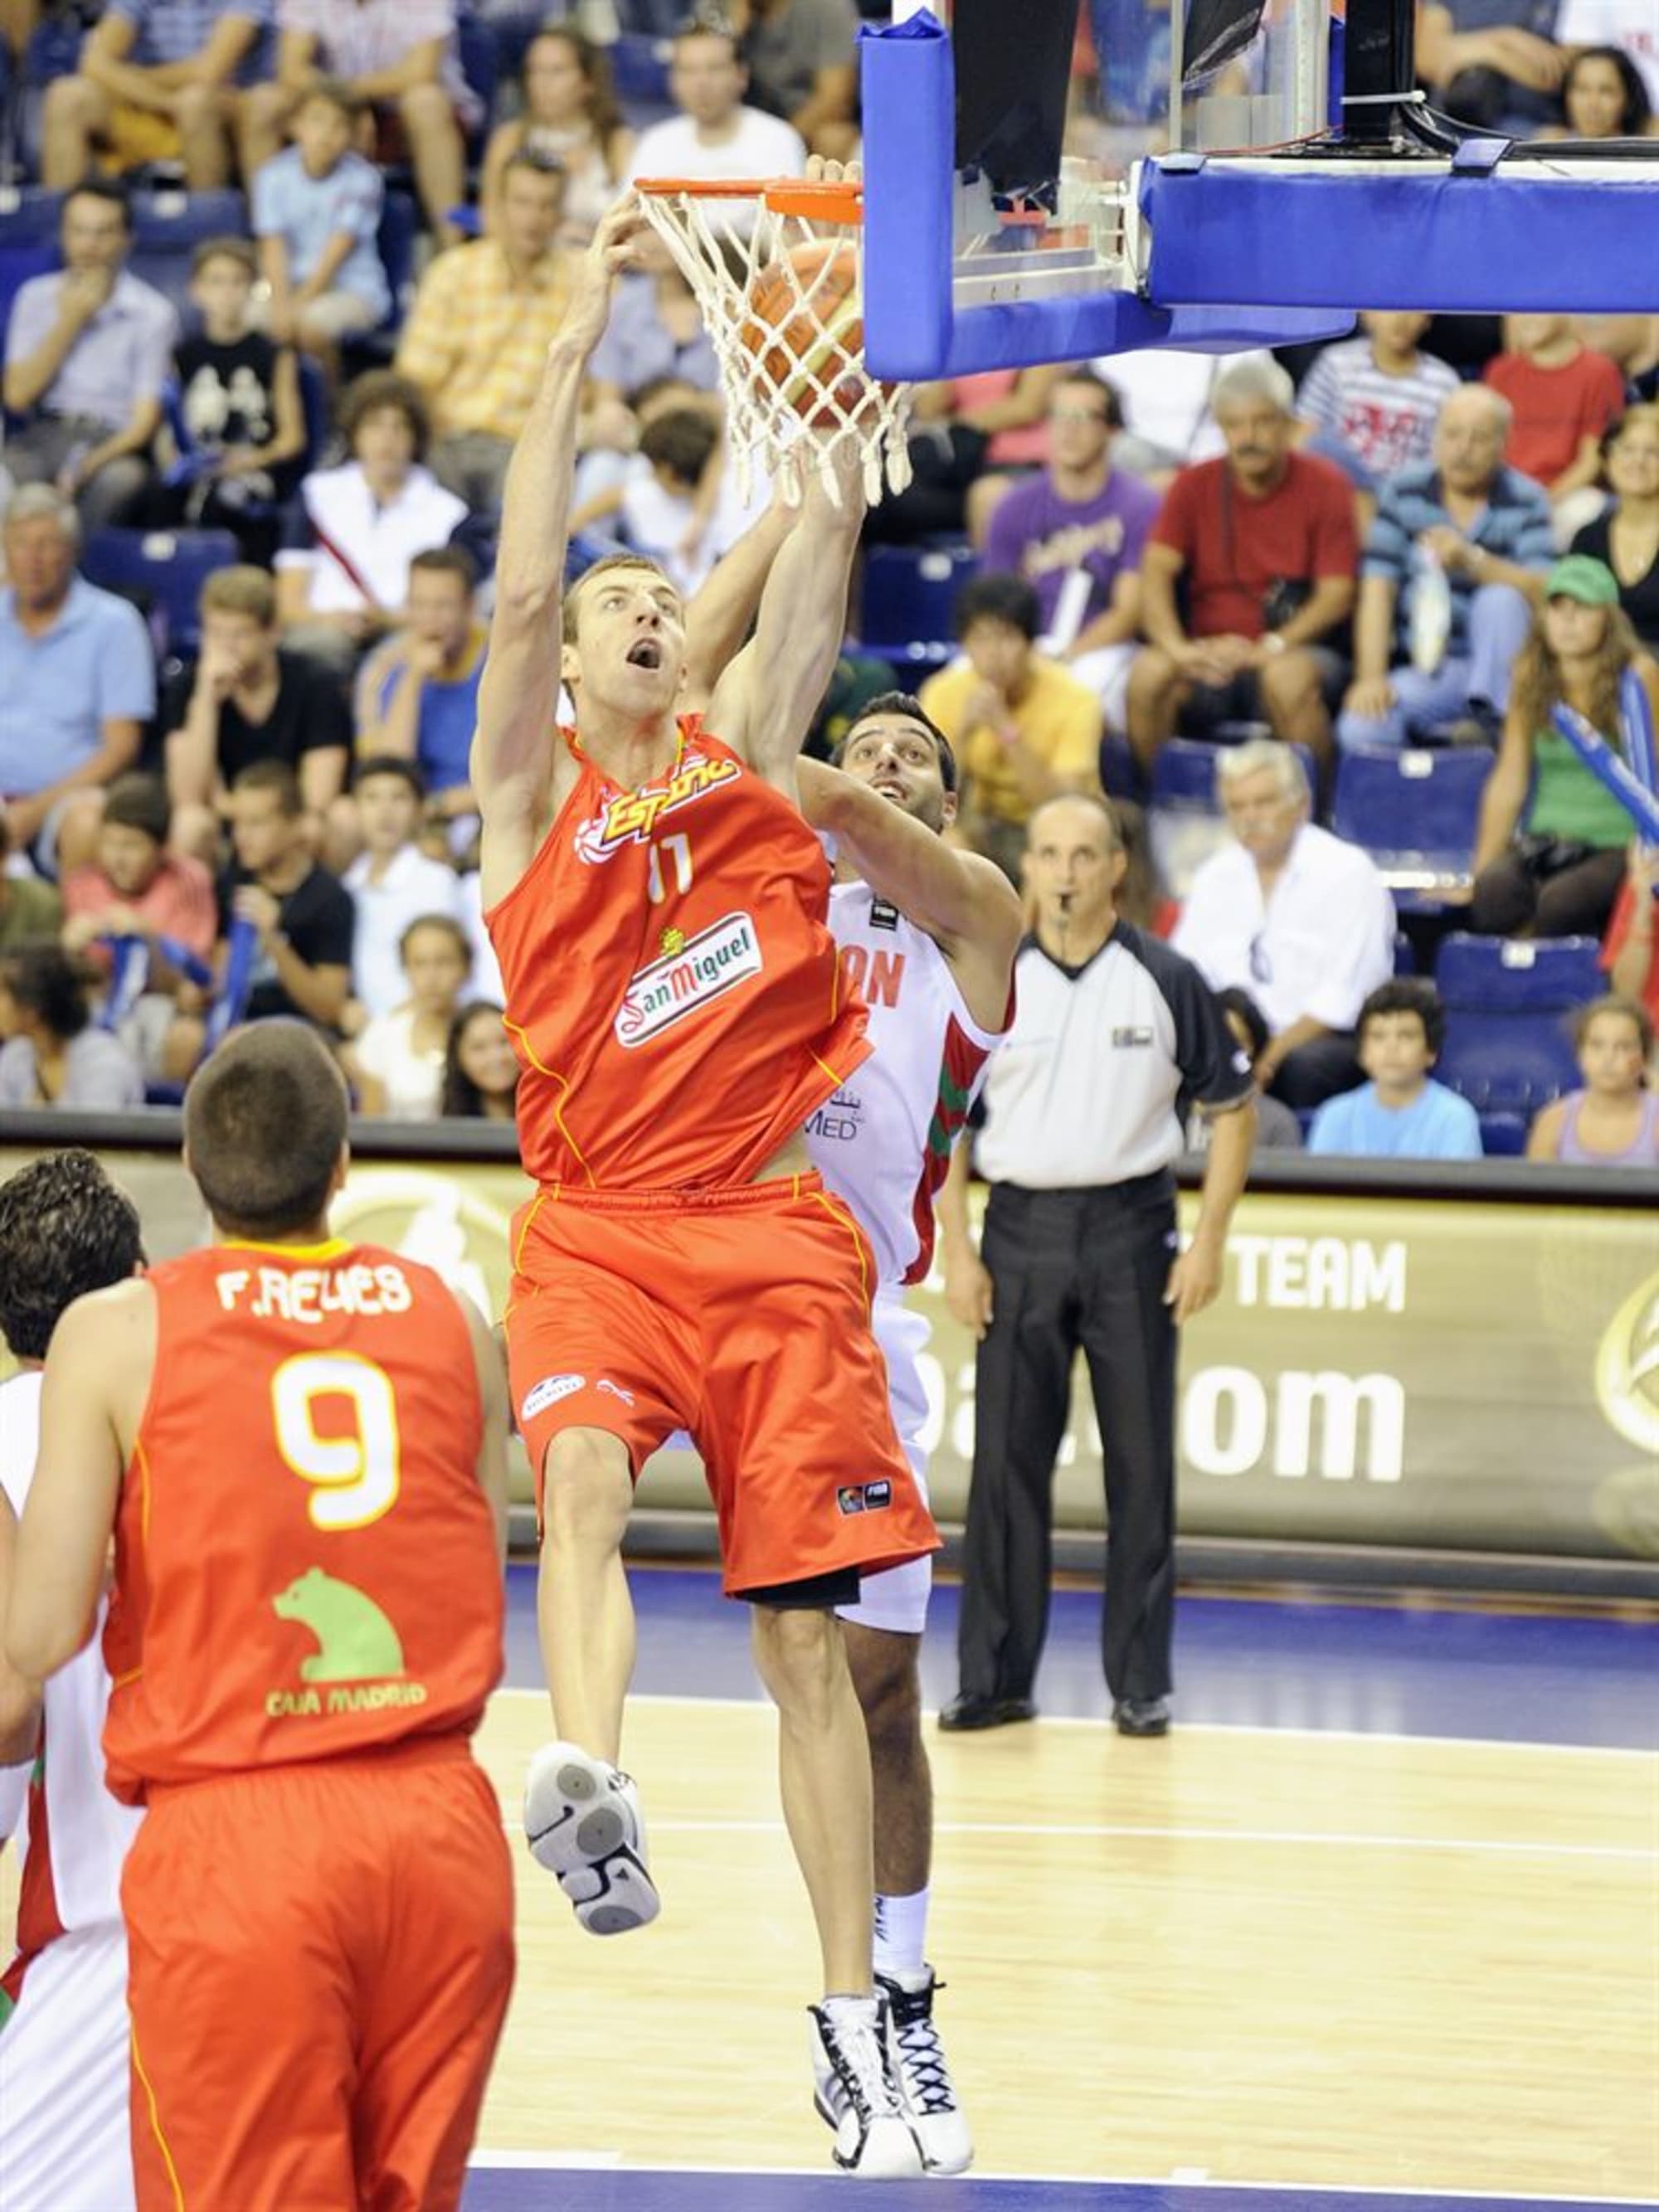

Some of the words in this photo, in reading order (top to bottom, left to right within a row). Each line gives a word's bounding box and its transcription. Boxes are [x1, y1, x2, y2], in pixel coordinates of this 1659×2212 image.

[648, 832, 693, 905] 17
[1226, 1235, 1405, 1312] TEAM
[271, 1350, 399, 1531] 9
[265, 1689, 322, 1718] CAJA
[327, 1682, 427, 1714] MADRID
